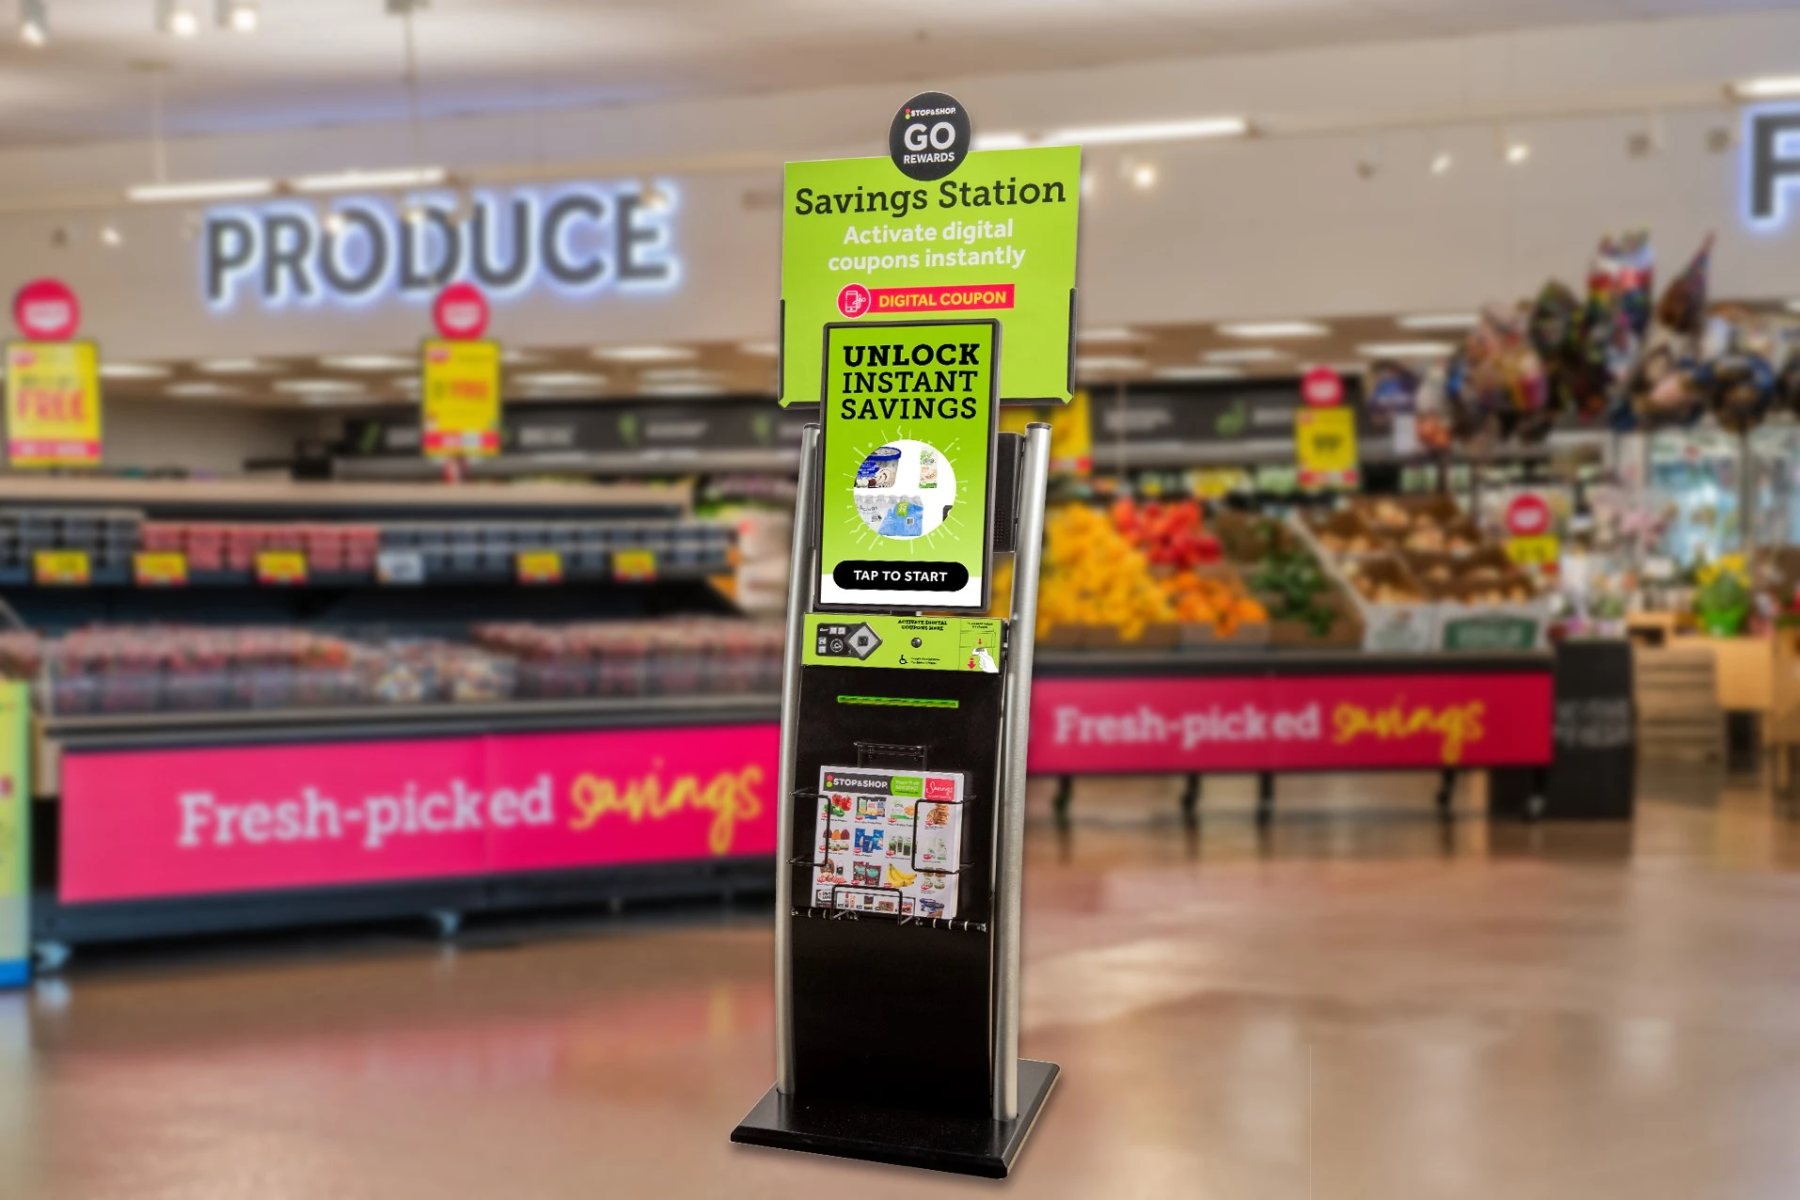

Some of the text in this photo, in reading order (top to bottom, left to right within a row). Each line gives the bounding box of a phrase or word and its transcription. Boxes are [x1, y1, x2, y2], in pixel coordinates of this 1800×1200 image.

[904, 121, 956, 151] GO
[903, 152, 955, 164] REWARDS
[795, 177, 1066, 218] Savings Station
[843, 218, 1013, 245] Activate digital
[203, 190, 675, 301] PRODUCE
[828, 245, 1026, 275] coupons instantly
[878, 291, 1006, 308] DIGITAL COUPON
[843, 343, 980, 367] UNLOCK
[842, 370, 978, 394] INSTANT
[841, 397, 977, 420] SAVINGS
[853, 569, 948, 582] TAP TO START
[1053, 703, 1322, 752] Fresh-picked
[833, 778, 888, 789] STOP&SHOP
[178, 772, 554, 849] Fresh-picked
